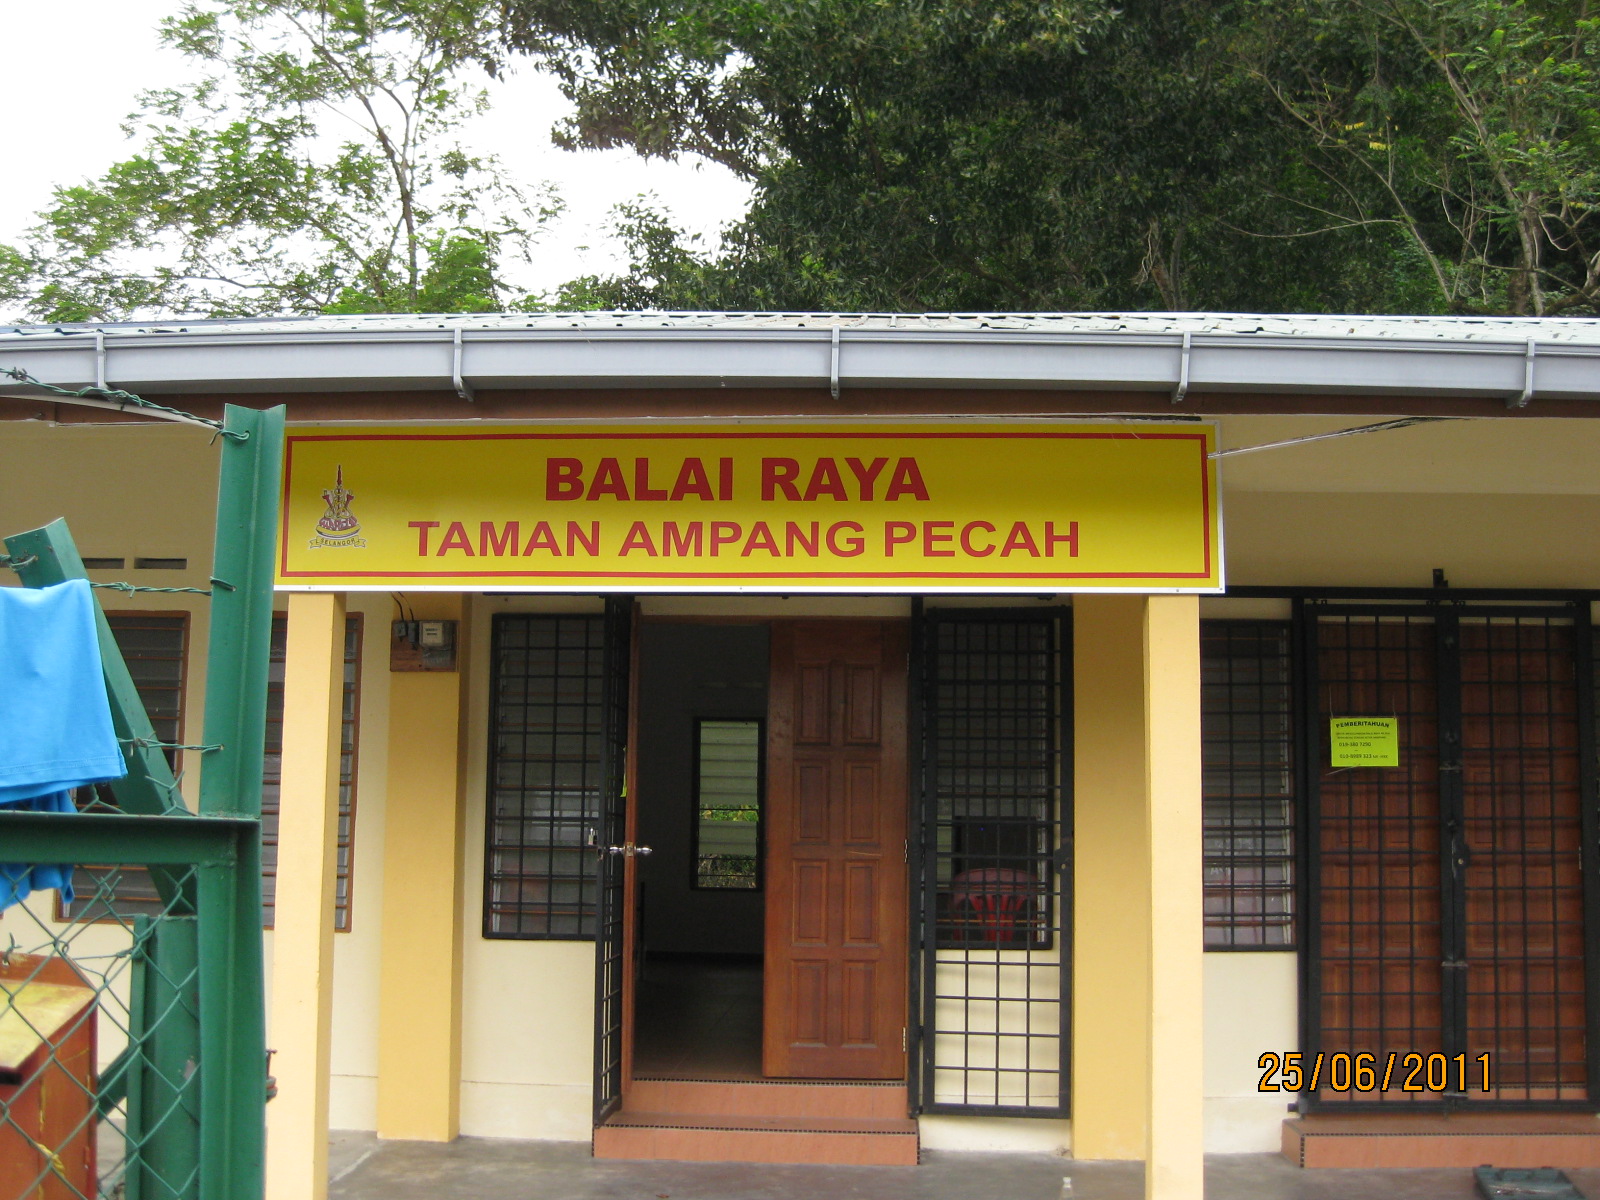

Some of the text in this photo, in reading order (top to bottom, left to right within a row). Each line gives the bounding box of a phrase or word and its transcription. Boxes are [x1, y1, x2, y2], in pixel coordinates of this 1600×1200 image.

[547, 457, 929, 501] BALAI RAYA
[320, 537, 356, 547] SELANGOR
[408, 521, 1079, 558] TAMAN AMPANG PECAH
